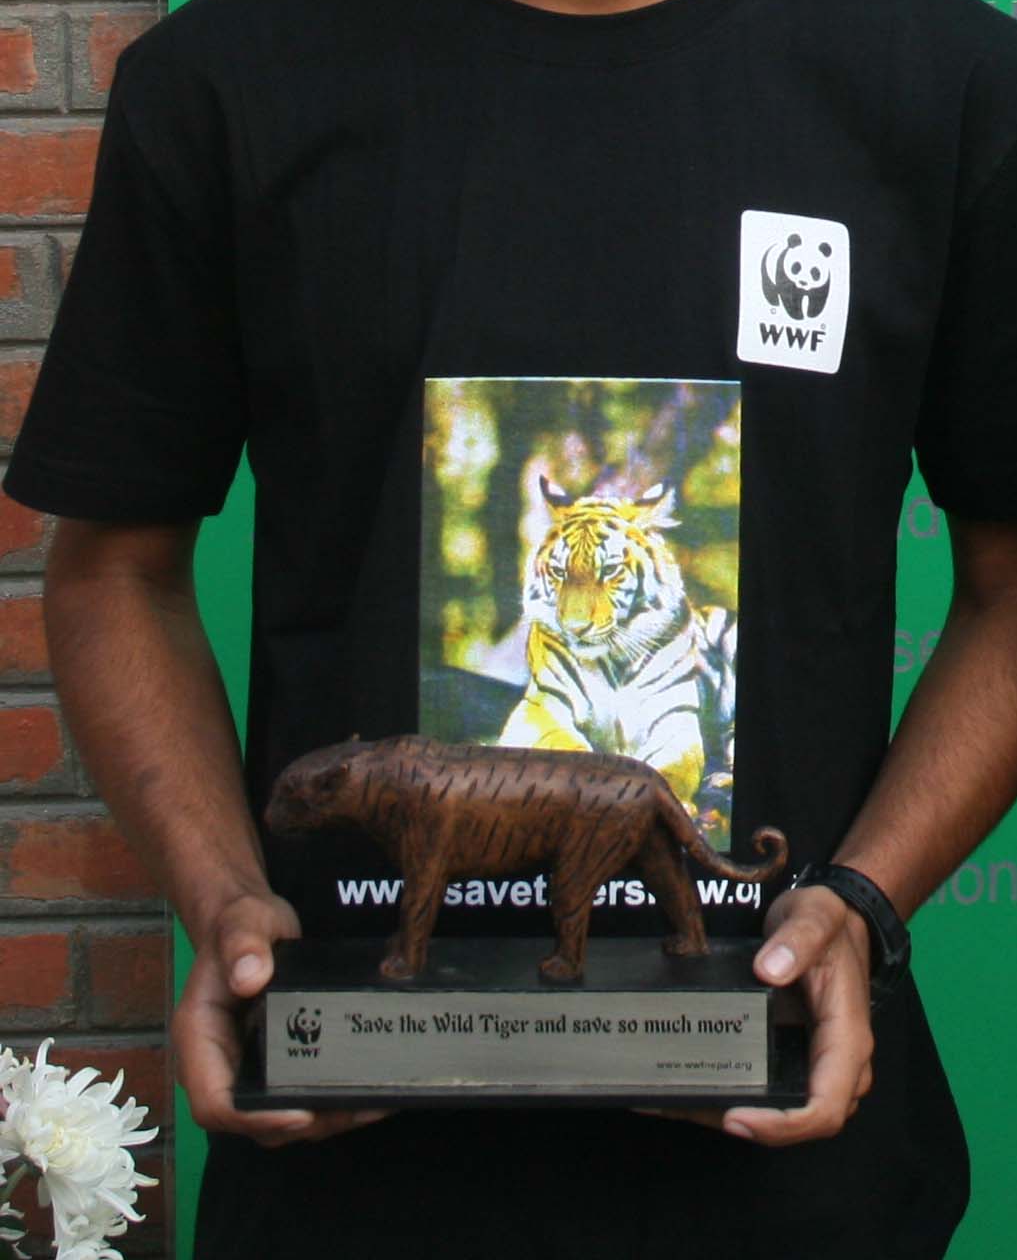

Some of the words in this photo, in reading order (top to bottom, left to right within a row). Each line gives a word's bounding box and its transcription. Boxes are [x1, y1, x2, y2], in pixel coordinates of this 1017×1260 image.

[759, 322, 827, 352] WWF
[400, 1013, 428, 1034] the
[432, 1012, 475, 1035] Wild
[479, 1013, 531, 1040] Tiger
[534, 1014, 568, 1035] and
[572, 1016, 613, 1035] save
[618, 1018, 639, 1034] so
[644, 1014, 693, 1035] much
[287, 1047, 321, 1059] WWF
